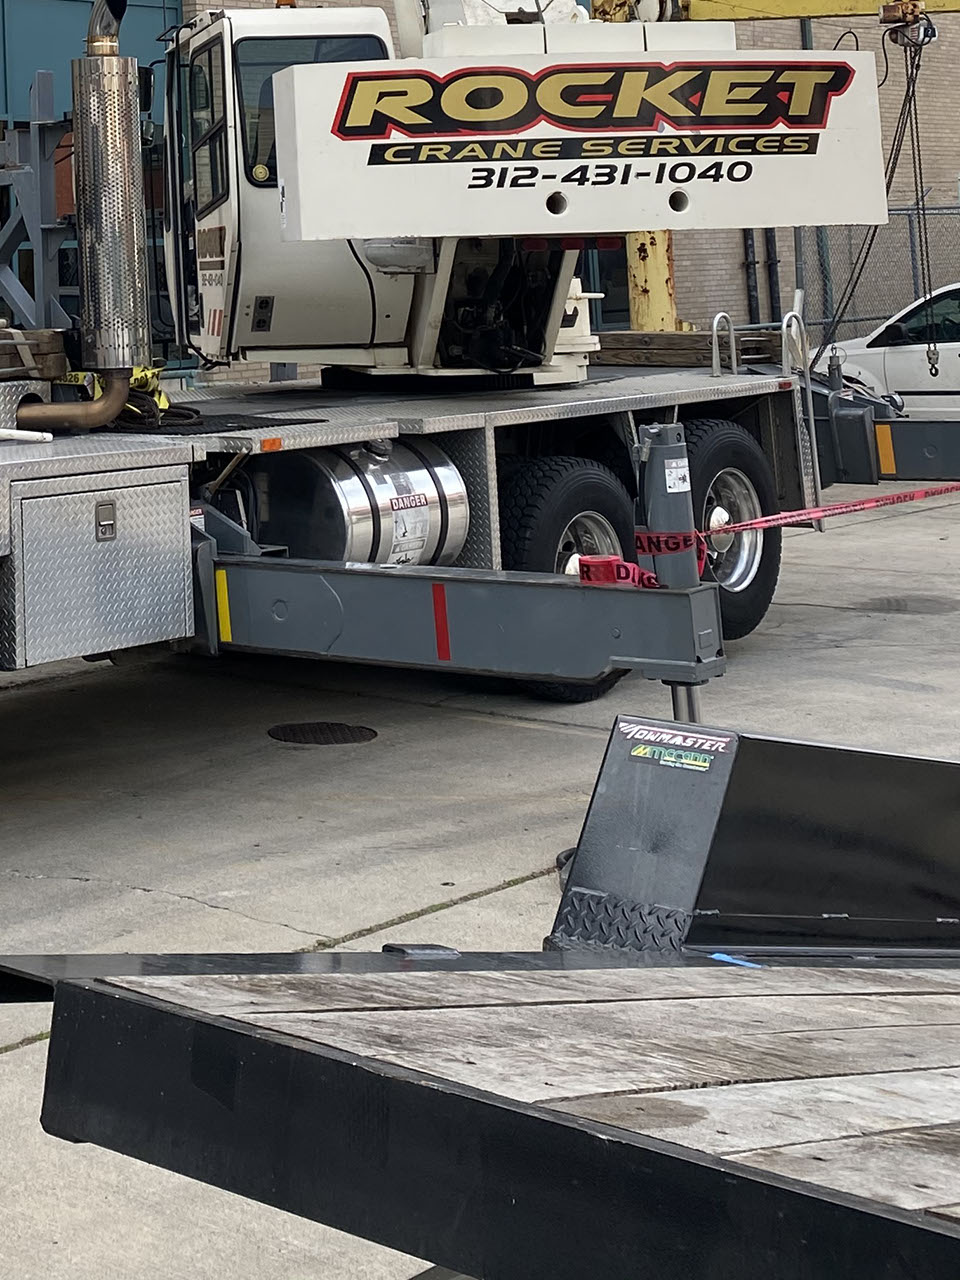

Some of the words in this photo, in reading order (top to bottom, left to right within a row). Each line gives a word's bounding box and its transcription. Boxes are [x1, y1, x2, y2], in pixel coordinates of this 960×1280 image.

[342, 68, 837, 129] ROCKET
[382, 140, 564, 162] CRANE
[580, 135, 810, 157] SERVICES
[467, 160, 754, 190] 312-431-1040
[391, 494, 427, 510] DANGER
[619, 722, 730, 753] TOWMASTER
